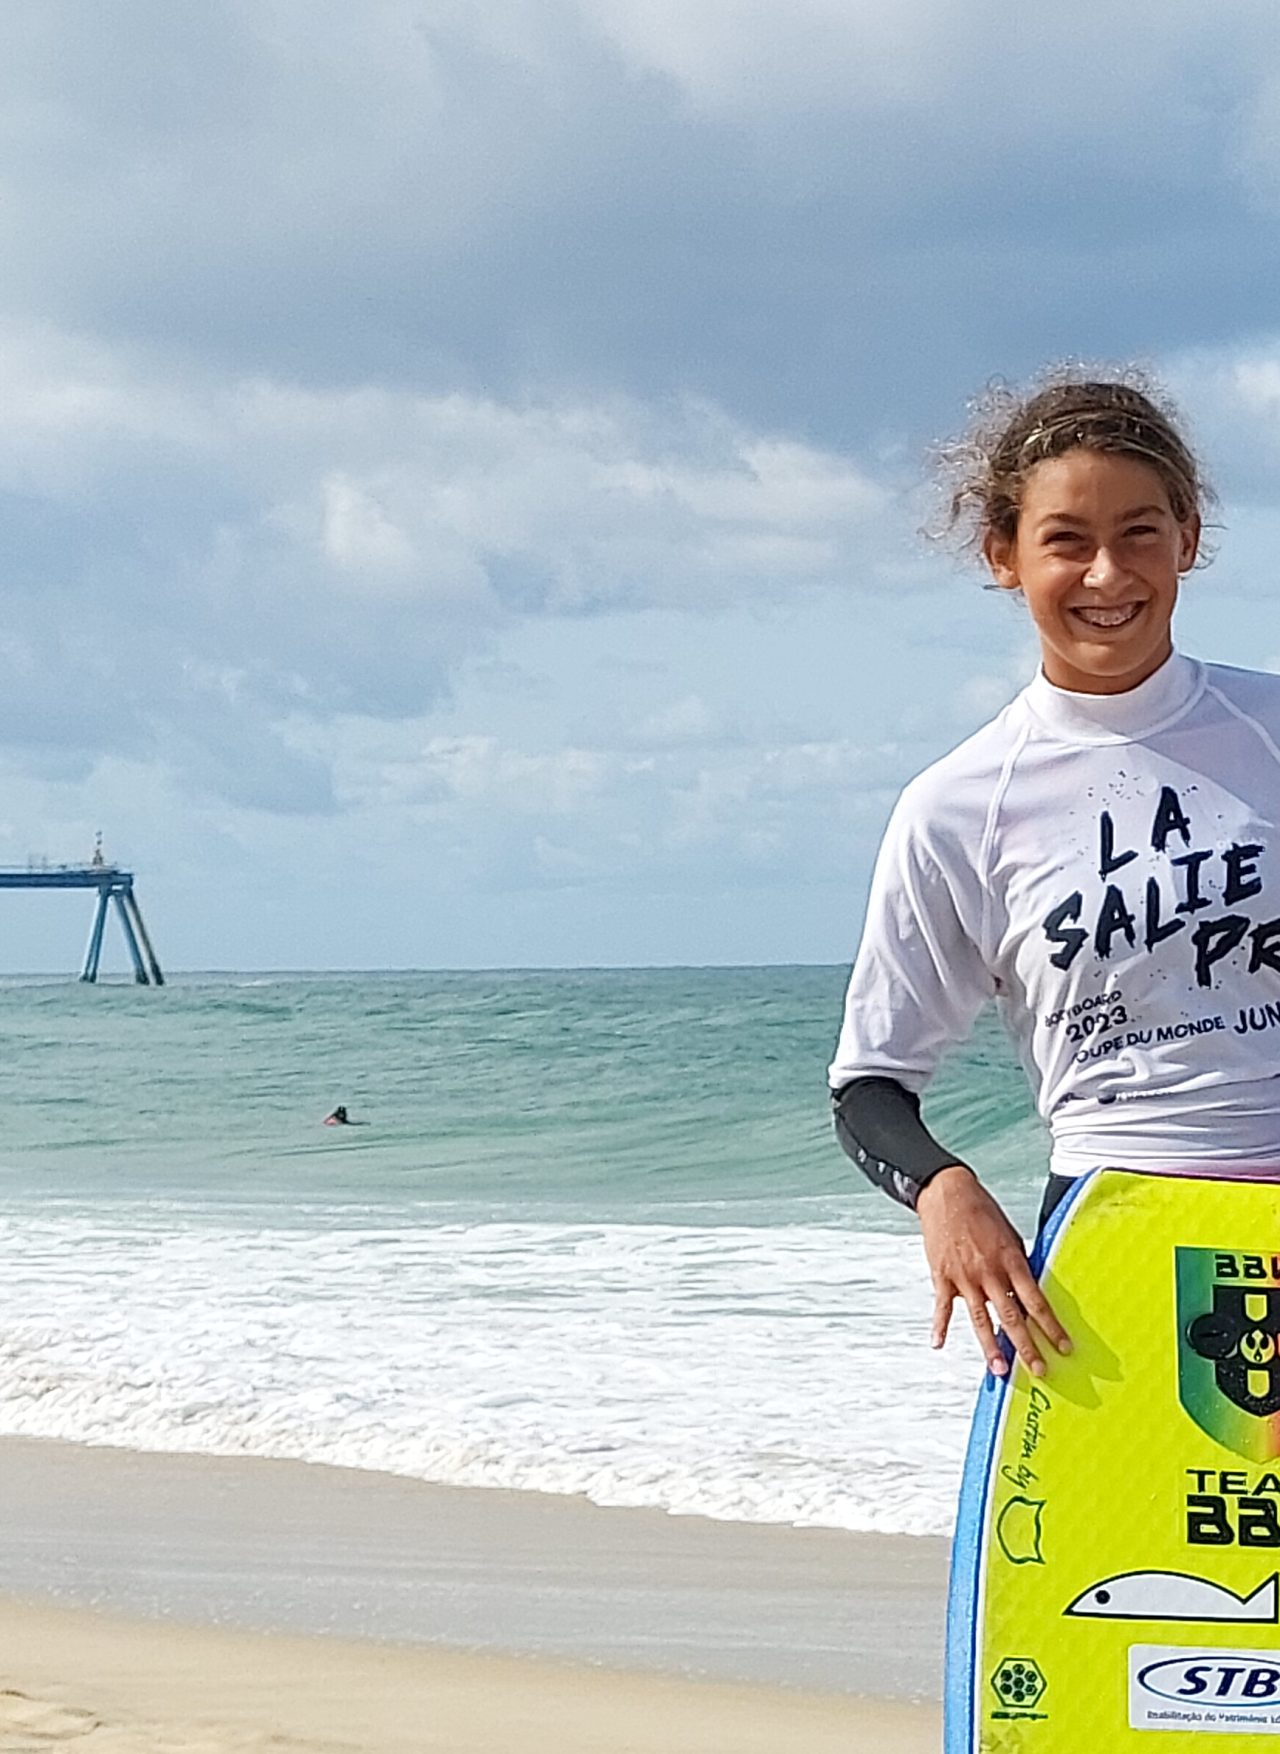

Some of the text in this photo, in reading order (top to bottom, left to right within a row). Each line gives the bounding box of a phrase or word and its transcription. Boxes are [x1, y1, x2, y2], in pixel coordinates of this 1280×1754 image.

[1099, 786, 1191, 881] LA
[1043, 842, 1265, 971] SALIE
[1065, 1005, 1127, 1042] 2023
[1126, 1030, 1152, 1046] DU
[1156, 1016, 1226, 1041] MONDE
[1001, 1464, 1040, 1489] by
[1176, 1666, 1280, 1698] STB
